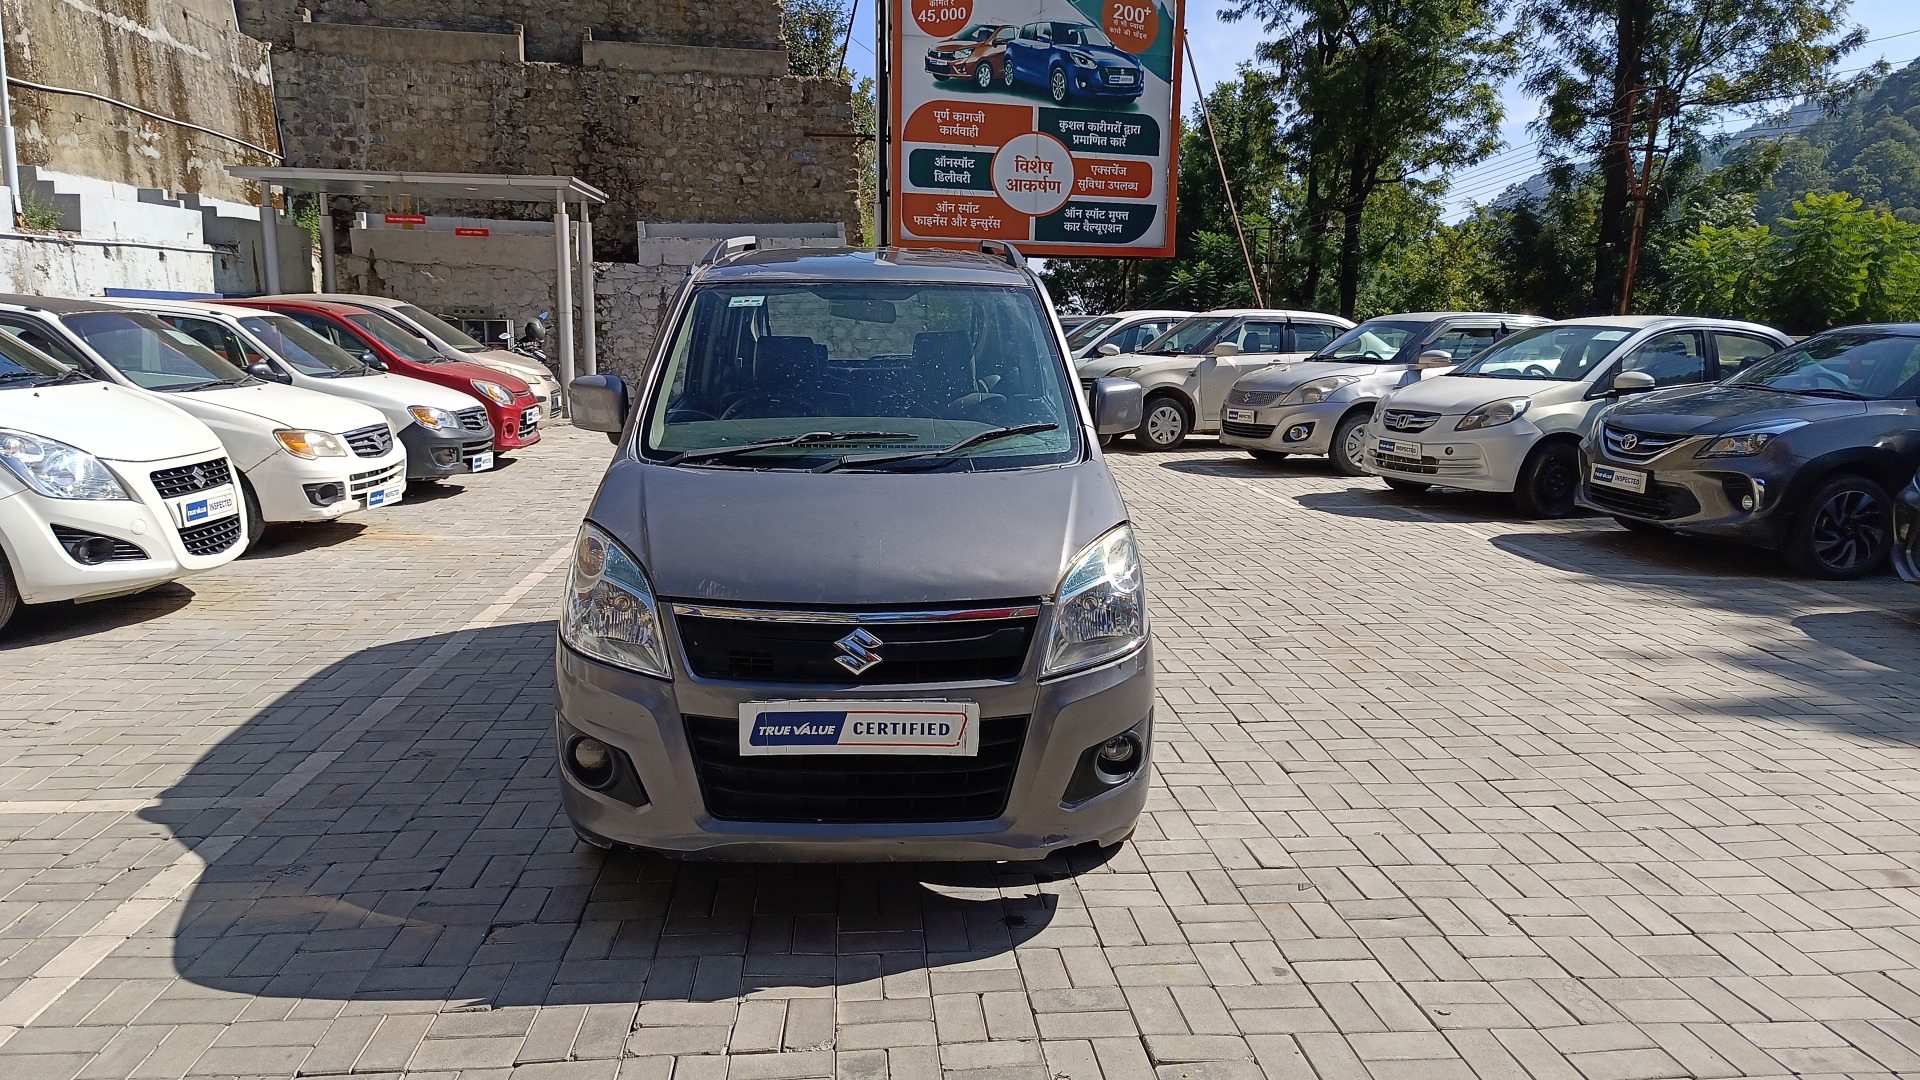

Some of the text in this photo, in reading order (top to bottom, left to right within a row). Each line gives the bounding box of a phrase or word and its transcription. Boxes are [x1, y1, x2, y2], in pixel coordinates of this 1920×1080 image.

[918, 7, 966, 23] 45,000
[1113, 3, 1151, 23] 200+
[934, 108, 985, 123] पूर्ण कागजी
[939, 124, 979, 138] कार्यवाही
[1059, 120, 1141, 135] कुशल कारीगरों द्वारा
[1073, 133, 1127, 147] प्रमाणित कारें
[934, 155, 975, 168] ऑनस्पॉट
[1015, 155, 1053, 174] विशेष
[934, 170, 971, 183] डिलीवरी
[1091, 164, 1127, 176] एक्सचेंज
[1006, 176, 1061, 194] आकर्षण
[1078, 177, 1138, 191] सुविधा उपलब्ध
[936, 201, 980, 213] ऑन स्पॉट
[913, 214, 948, 227] फाइनेंस
[951, 214, 967, 227] और
[1064, 207, 1129, 222] ऑन स्पॉट मुफ्त
[1064, 219, 1122, 235] कार वैल्यूएशन
[1615, 475, 1639, 485] INSPECTED
[209, 498, 232, 511] INSPECTED
[853, 722, 950, 736] CERTIFIED
